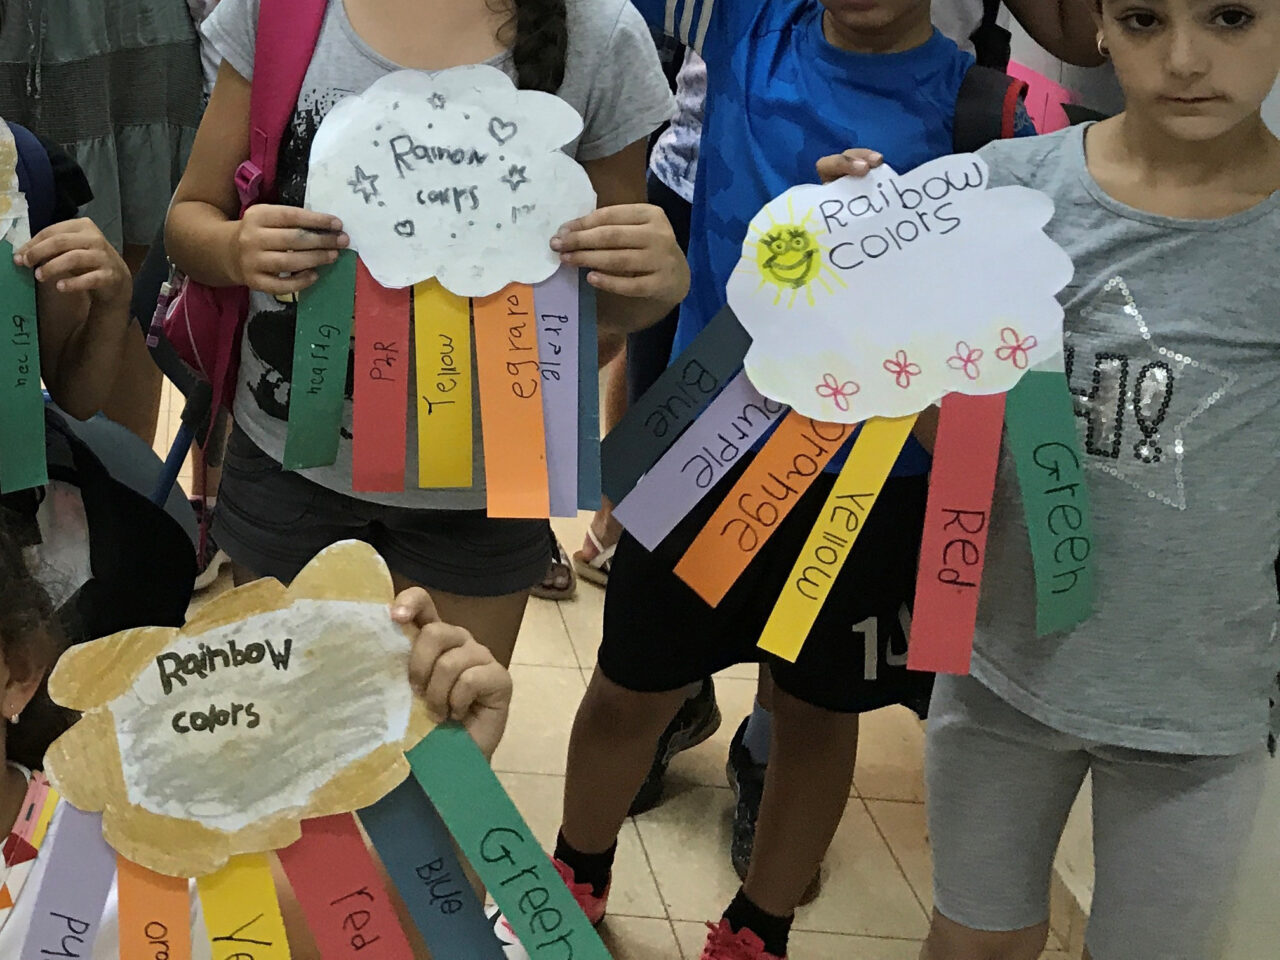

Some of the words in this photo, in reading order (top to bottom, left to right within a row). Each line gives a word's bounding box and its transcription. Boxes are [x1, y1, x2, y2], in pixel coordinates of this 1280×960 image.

[644, 358, 718, 439] Blue
[936, 507, 988, 591] Red
[1031, 440, 1092, 596] Green
[157, 637, 294, 696] Rainbow
